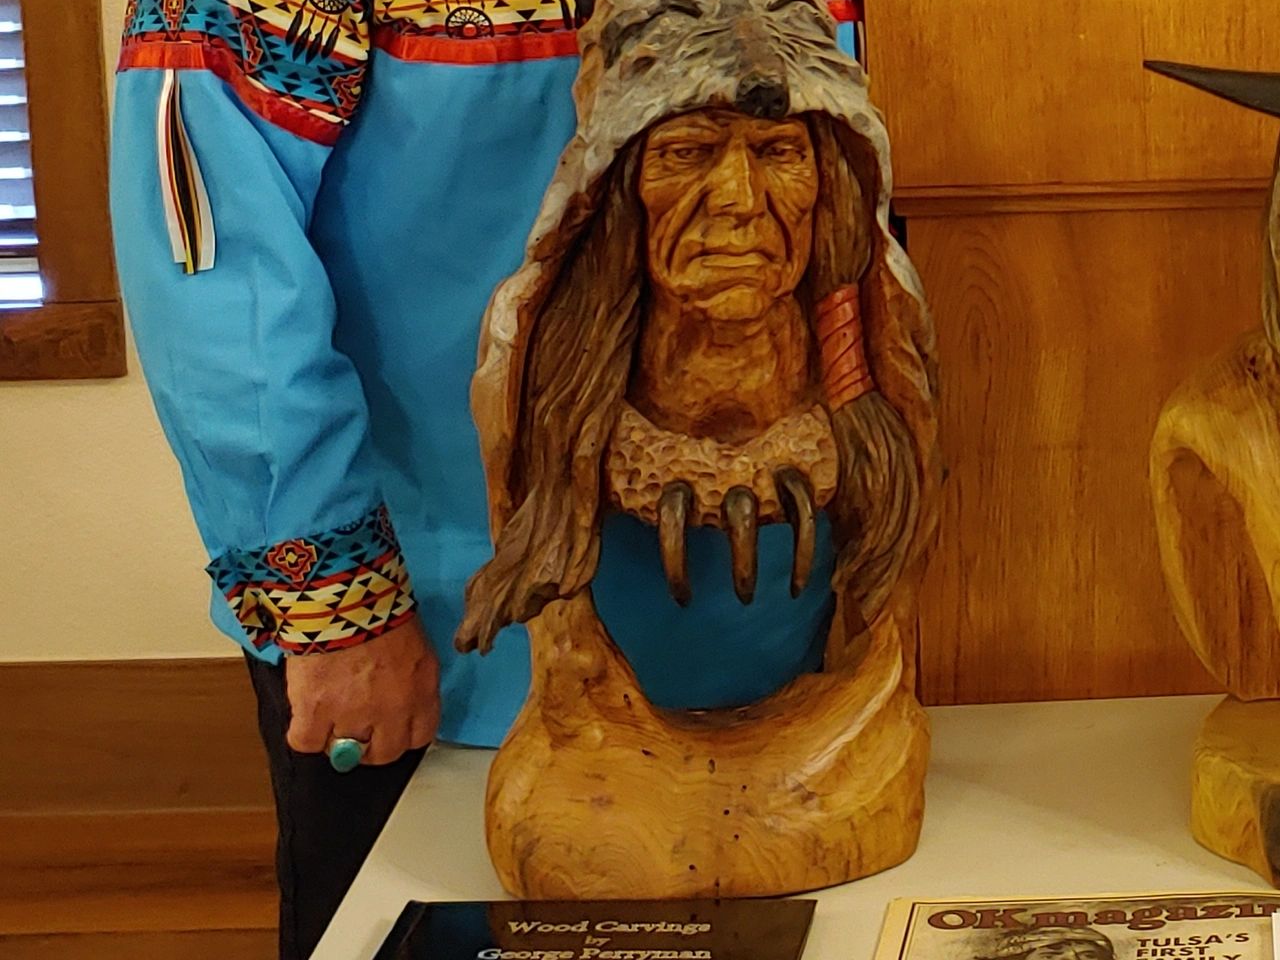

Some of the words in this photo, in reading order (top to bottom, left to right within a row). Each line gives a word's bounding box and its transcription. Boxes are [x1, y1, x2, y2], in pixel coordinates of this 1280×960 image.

[927, 908, 1030, 930] OK
[508, 920, 590, 933] Wood
[594, 921, 711, 935] Carvings
[584, 935, 611, 947] by
[1136, 933, 1250, 947] TULSA'S
[477, 948, 575, 960] George
[579, 948, 712, 960] Perryman
[1136, 946, 1210, 957] FIRST
